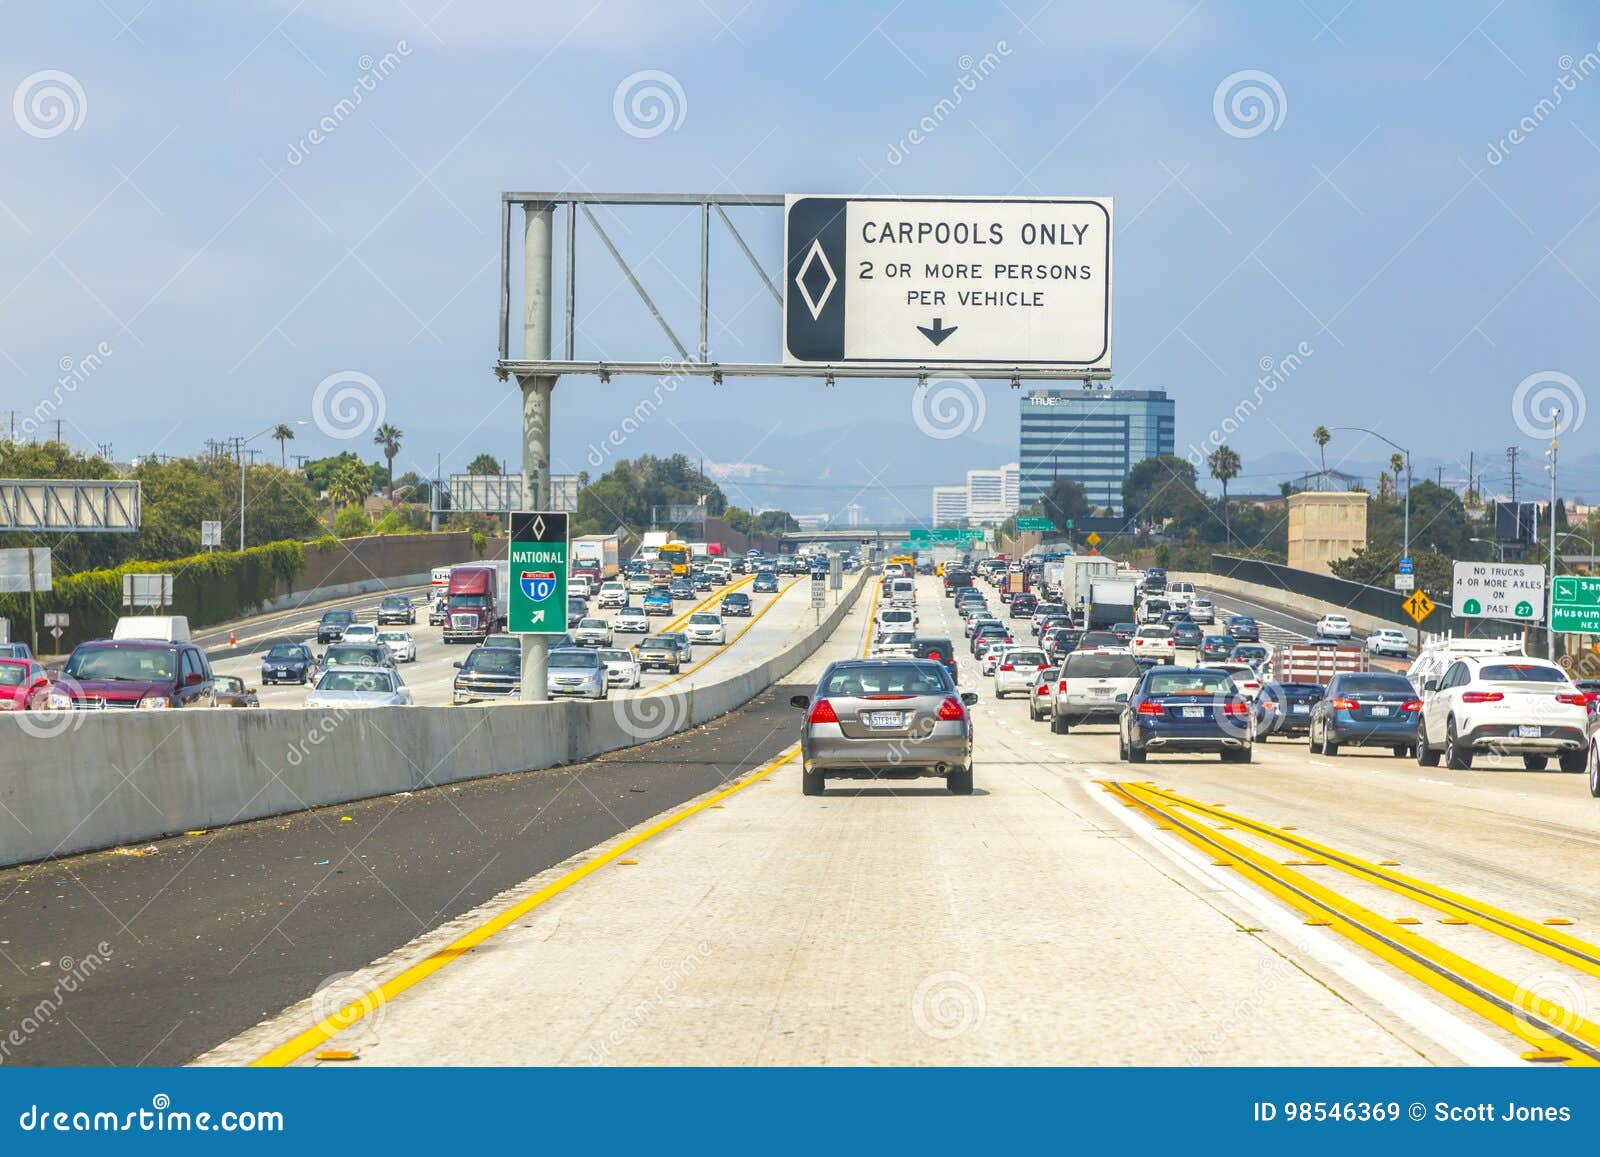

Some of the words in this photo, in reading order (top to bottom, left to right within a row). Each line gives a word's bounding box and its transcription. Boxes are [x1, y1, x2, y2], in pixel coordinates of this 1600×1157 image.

[862, 221, 1003, 244] CARPOOLS
[1021, 223, 1090, 245] ONLY
[859, 261, 874, 280] 2
[885, 263, 912, 279] OR
[925, 264, 982, 279] MORE
[994, 264, 1092, 280] PERSONS
[907, 290, 946, 306] PER
[957, 291, 1045, 307] VEHICLE
[512, 551, 564, 564] NATIONAL
[1473, 567, 1486, 575] NO
[1491, 568, 1525, 576] TRUCKS
[530, 582, 548, 597] 10
[1467, 578, 1479, 586] OR
[1484, 579, 1508, 588] MORE
[1512, 580, 1541, 589] AXLES
[1492, 591, 1505, 599] ON
[1486, 604, 1509, 613] PAST
[1518, 606, 1530, 614] 27
[1554, 608, 1600, 619] Museum
